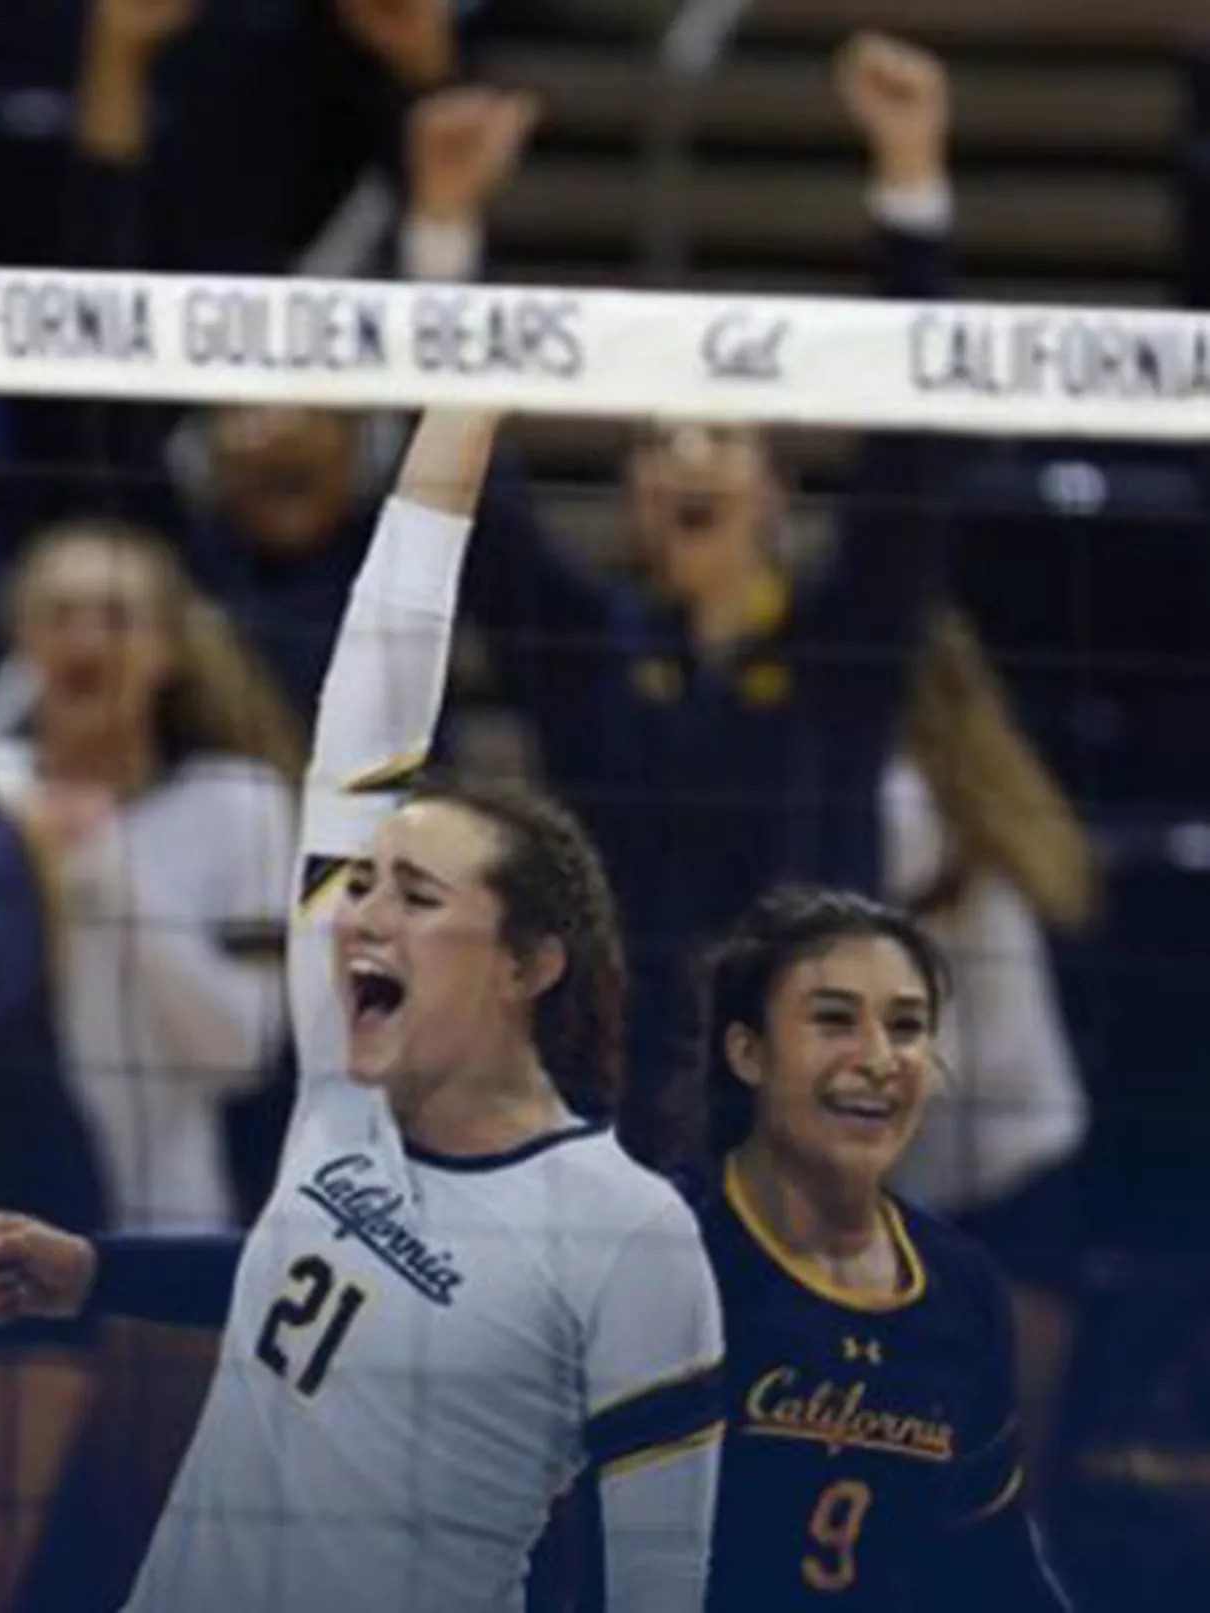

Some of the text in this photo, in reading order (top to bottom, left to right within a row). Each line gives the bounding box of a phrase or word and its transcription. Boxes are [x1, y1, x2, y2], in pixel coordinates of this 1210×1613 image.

[182, 287, 388, 369] GOLDEN
[412, 296, 584, 378] BEARS
[297, 1152, 465, 1307] California
[252, 1250, 370, 1401] 21
[743, 1366, 954, 1463] California
[800, 1477, 873, 1592] 9
